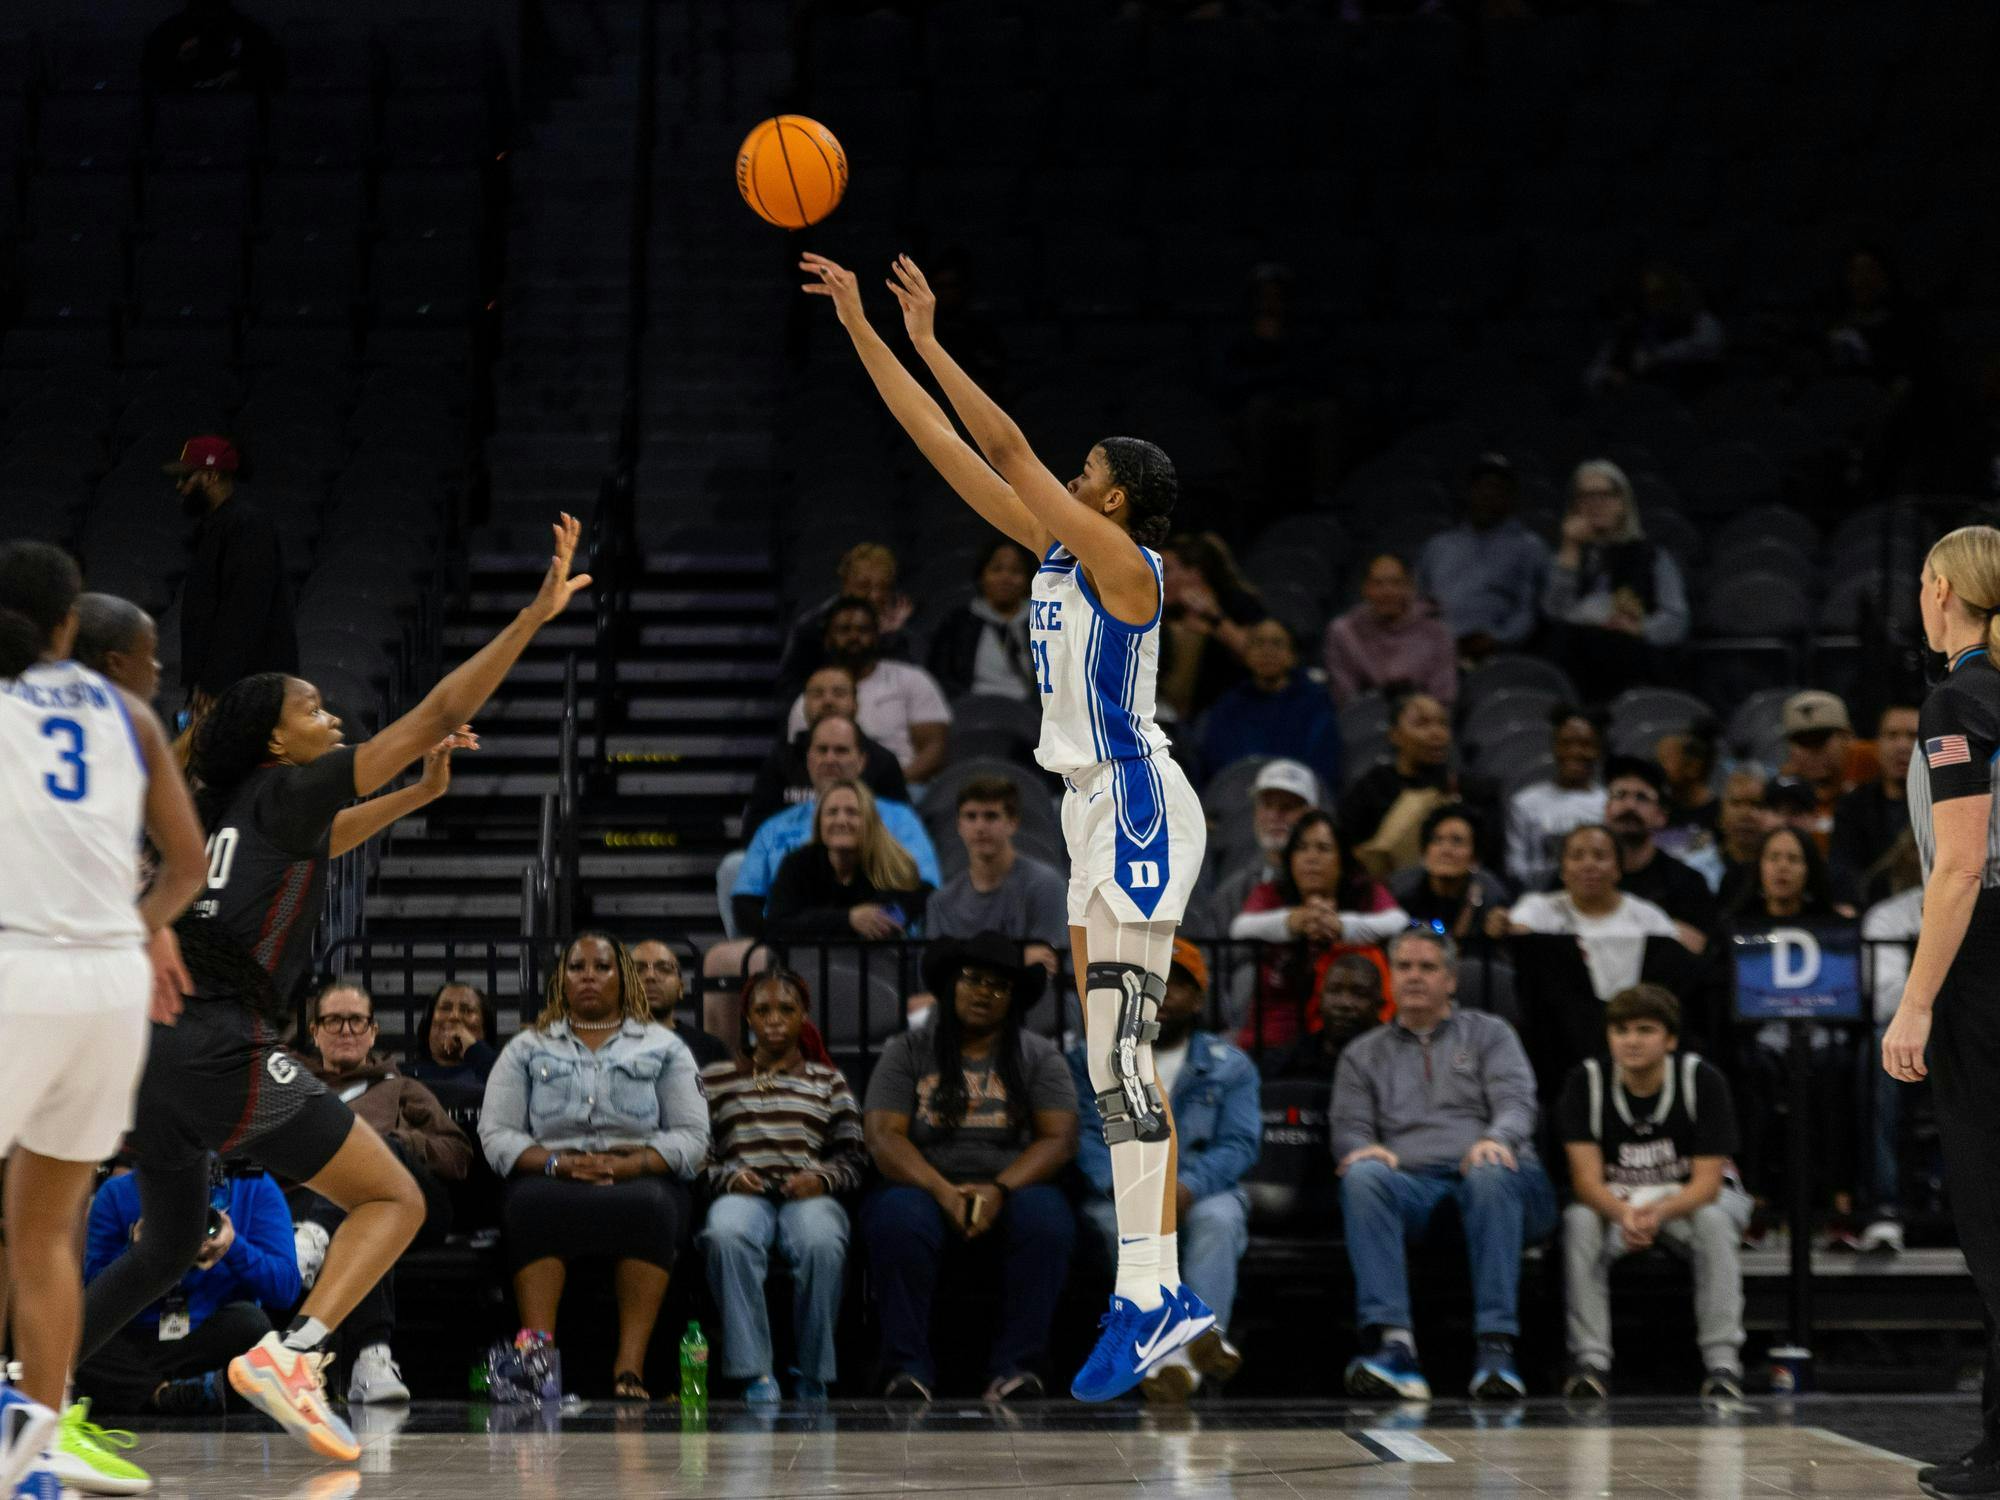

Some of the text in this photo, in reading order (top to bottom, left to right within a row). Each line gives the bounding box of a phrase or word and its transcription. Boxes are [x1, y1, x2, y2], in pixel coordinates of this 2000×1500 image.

[41, 716, 87, 802] 3
[204, 827, 240, 889] 0
[1127, 860, 1161, 889] D
[1771, 926, 1822, 989] D
